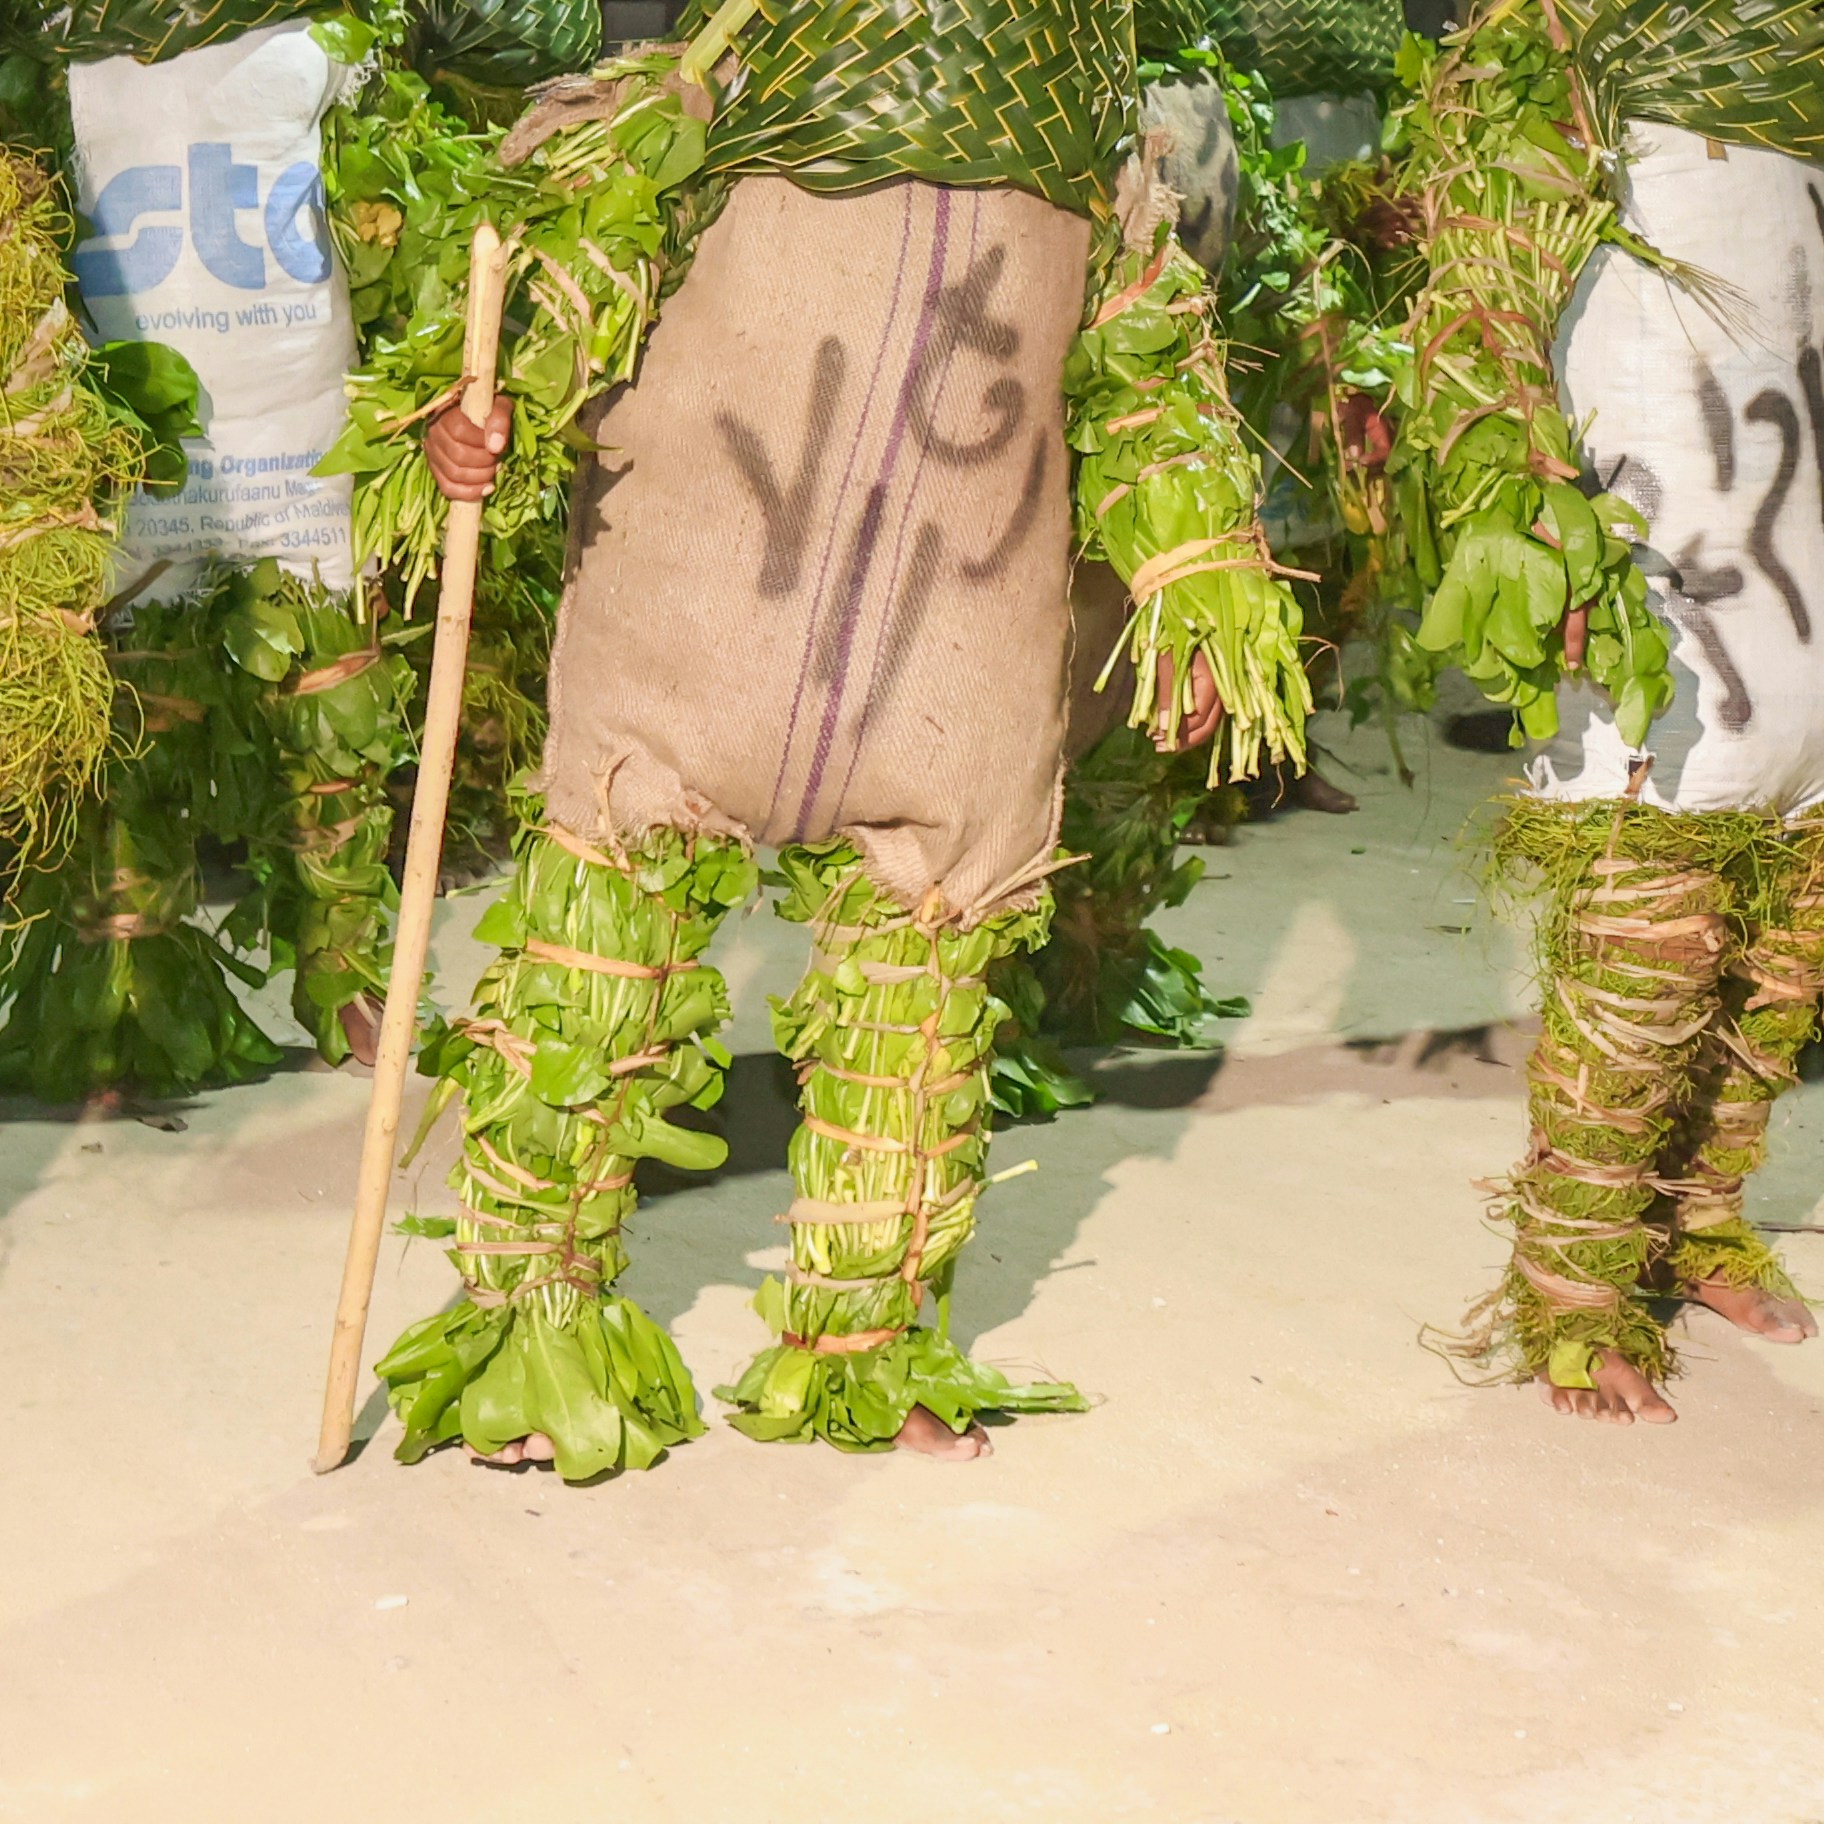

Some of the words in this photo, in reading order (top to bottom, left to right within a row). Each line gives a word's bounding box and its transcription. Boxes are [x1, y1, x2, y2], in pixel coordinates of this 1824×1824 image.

[75, 142, 334, 298] sto
[135, 306, 230, 333] evolving
[236, 302, 279, 327] with
[282, 302, 317, 327] you
[220, 449, 324, 477] Organizati
[280, 527, 346, 549] 3344511
